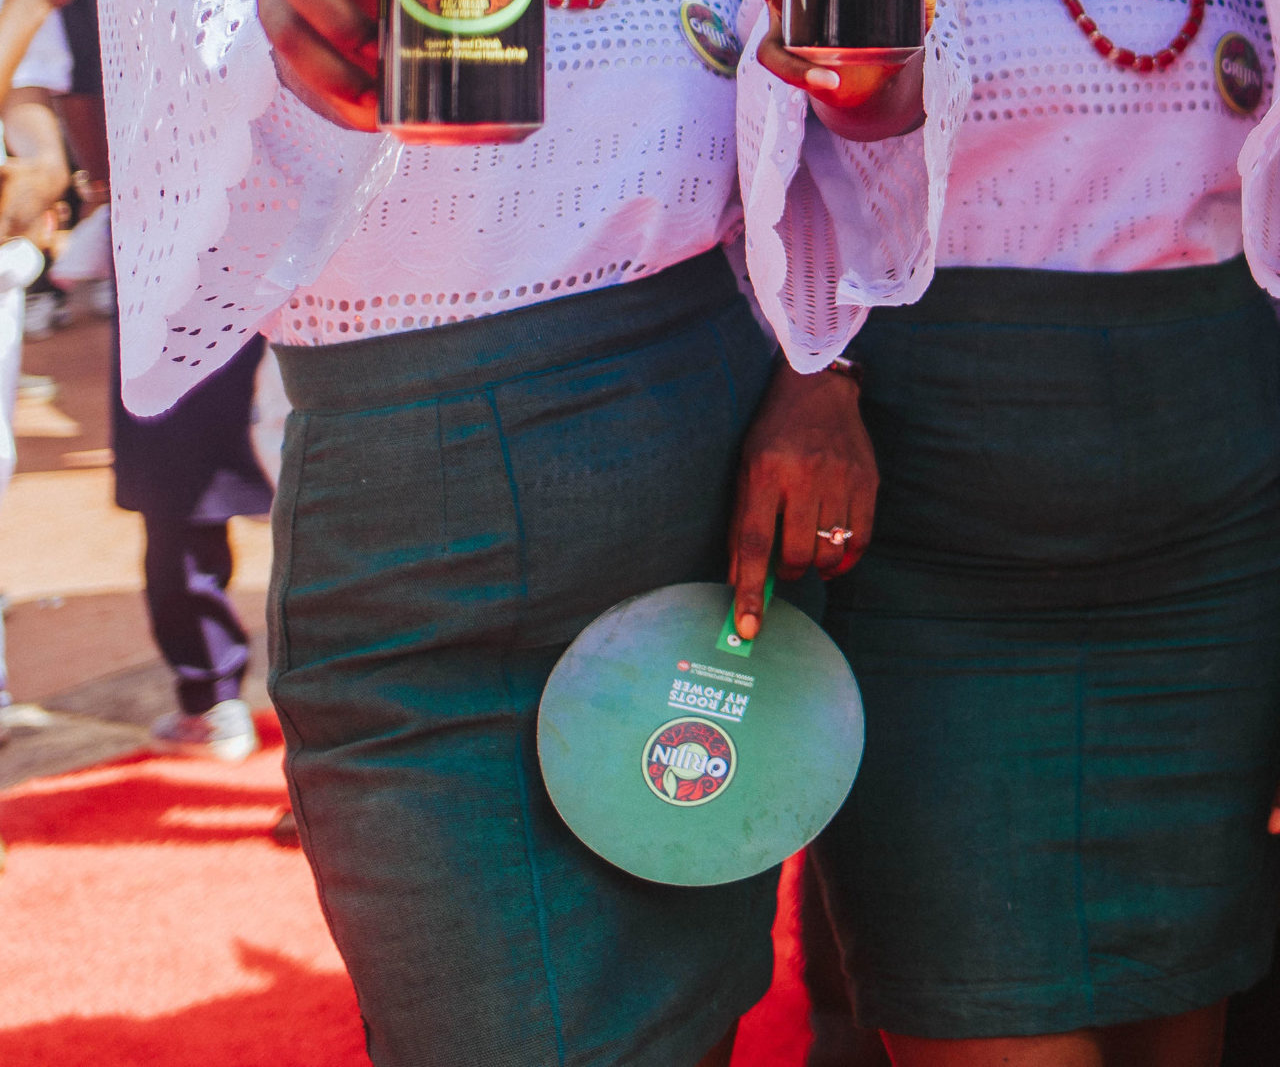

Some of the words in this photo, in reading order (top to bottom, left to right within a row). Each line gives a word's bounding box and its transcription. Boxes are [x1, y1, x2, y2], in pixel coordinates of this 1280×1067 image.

[672, 679, 725, 700] POWER
[669, 690, 719, 710] ROOTS
[720, 702, 745, 716] MY
[726, 693, 749, 707] MY
[652, 744, 728, 778] ORIJIN
